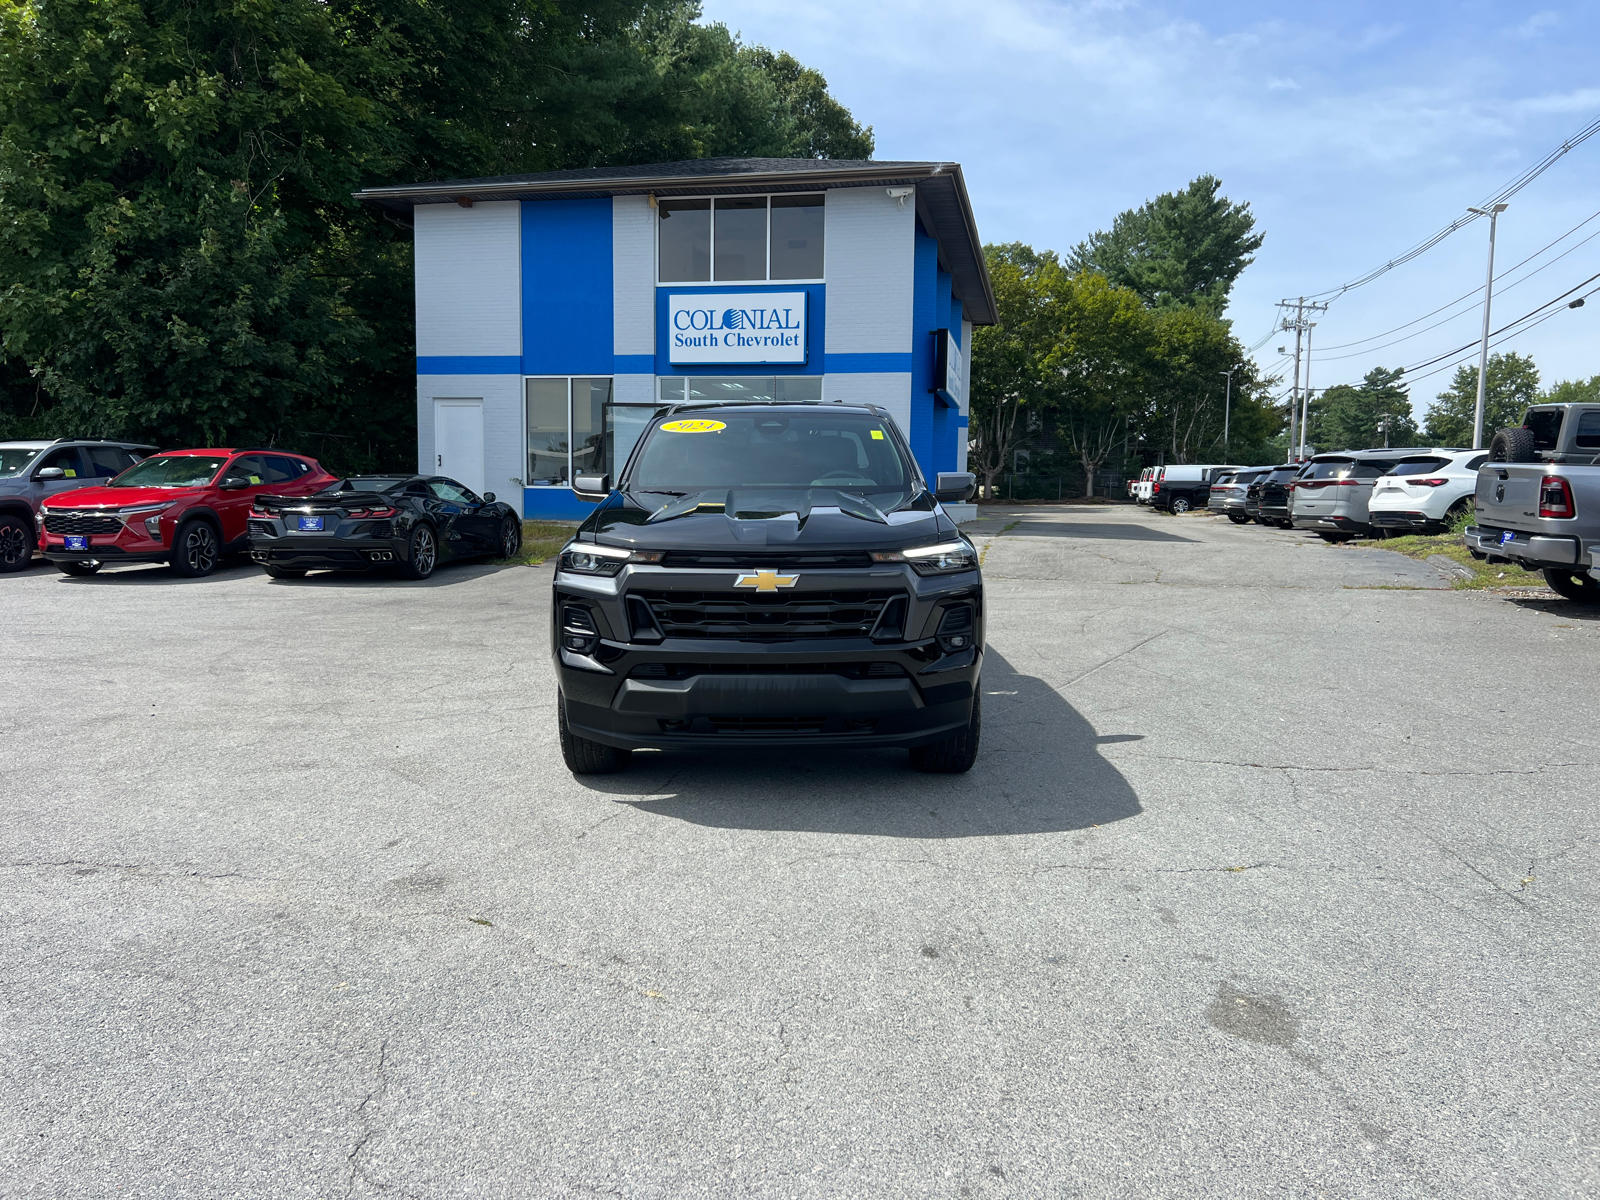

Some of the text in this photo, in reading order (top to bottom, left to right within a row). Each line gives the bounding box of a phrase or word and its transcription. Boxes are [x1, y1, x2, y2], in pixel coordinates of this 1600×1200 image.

[674, 308, 800, 331] COLONIAL
[675, 332, 800, 347] South Chevrolet
